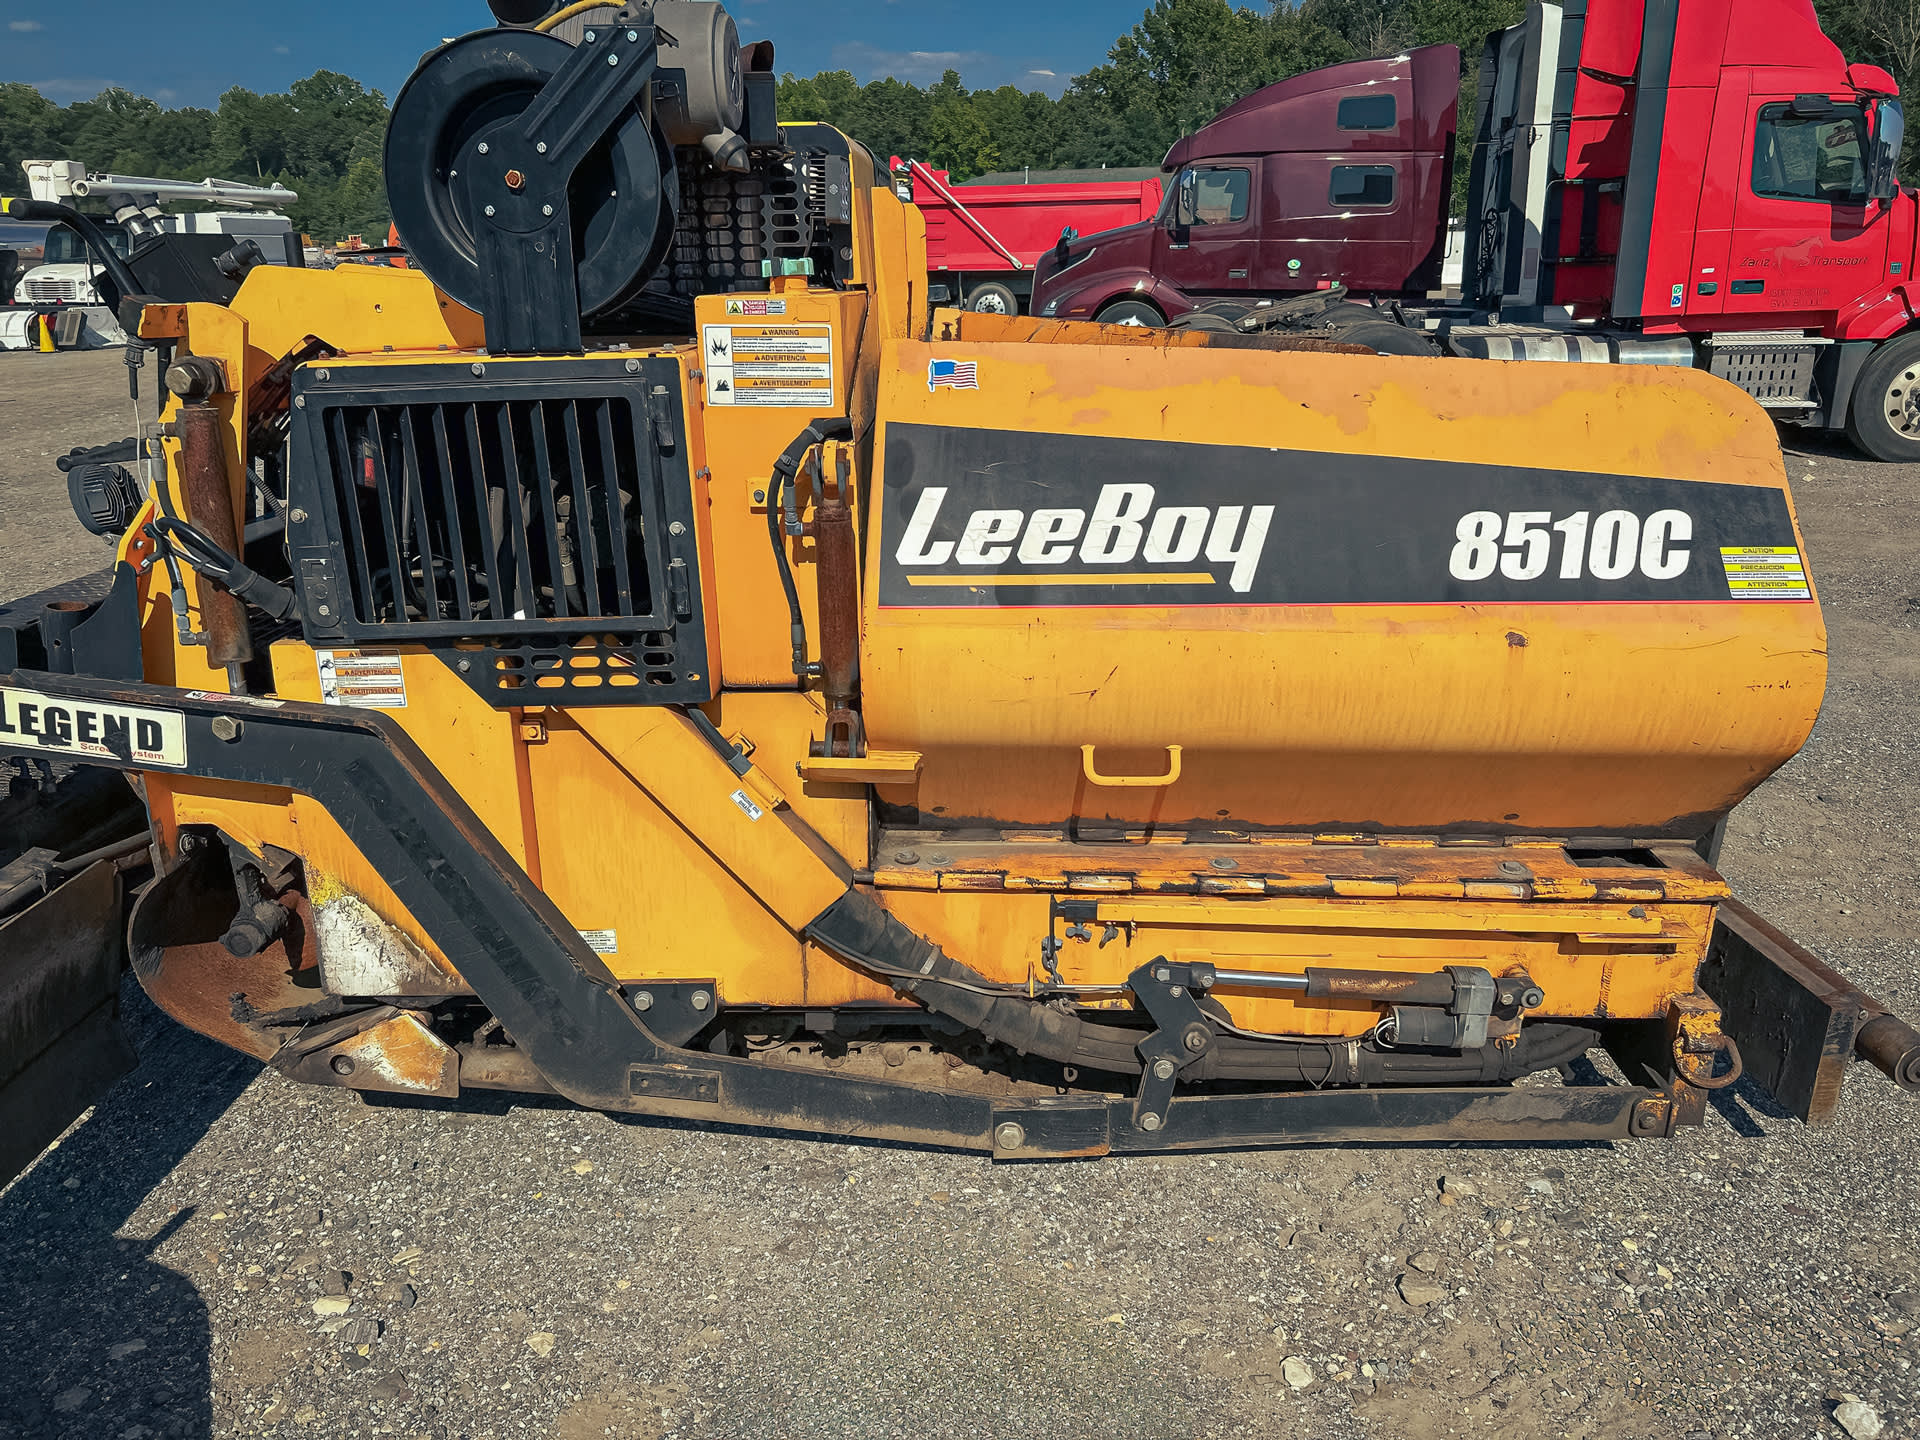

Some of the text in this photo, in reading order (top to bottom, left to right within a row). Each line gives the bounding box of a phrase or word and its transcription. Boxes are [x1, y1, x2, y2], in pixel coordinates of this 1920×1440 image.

[1812, 256, 1868, 267] Transport
[895, 483, 1275, 593] LeeBoy
[1449, 509, 1692, 581] 8510C
[0, 691, 163, 752] LEGEND
